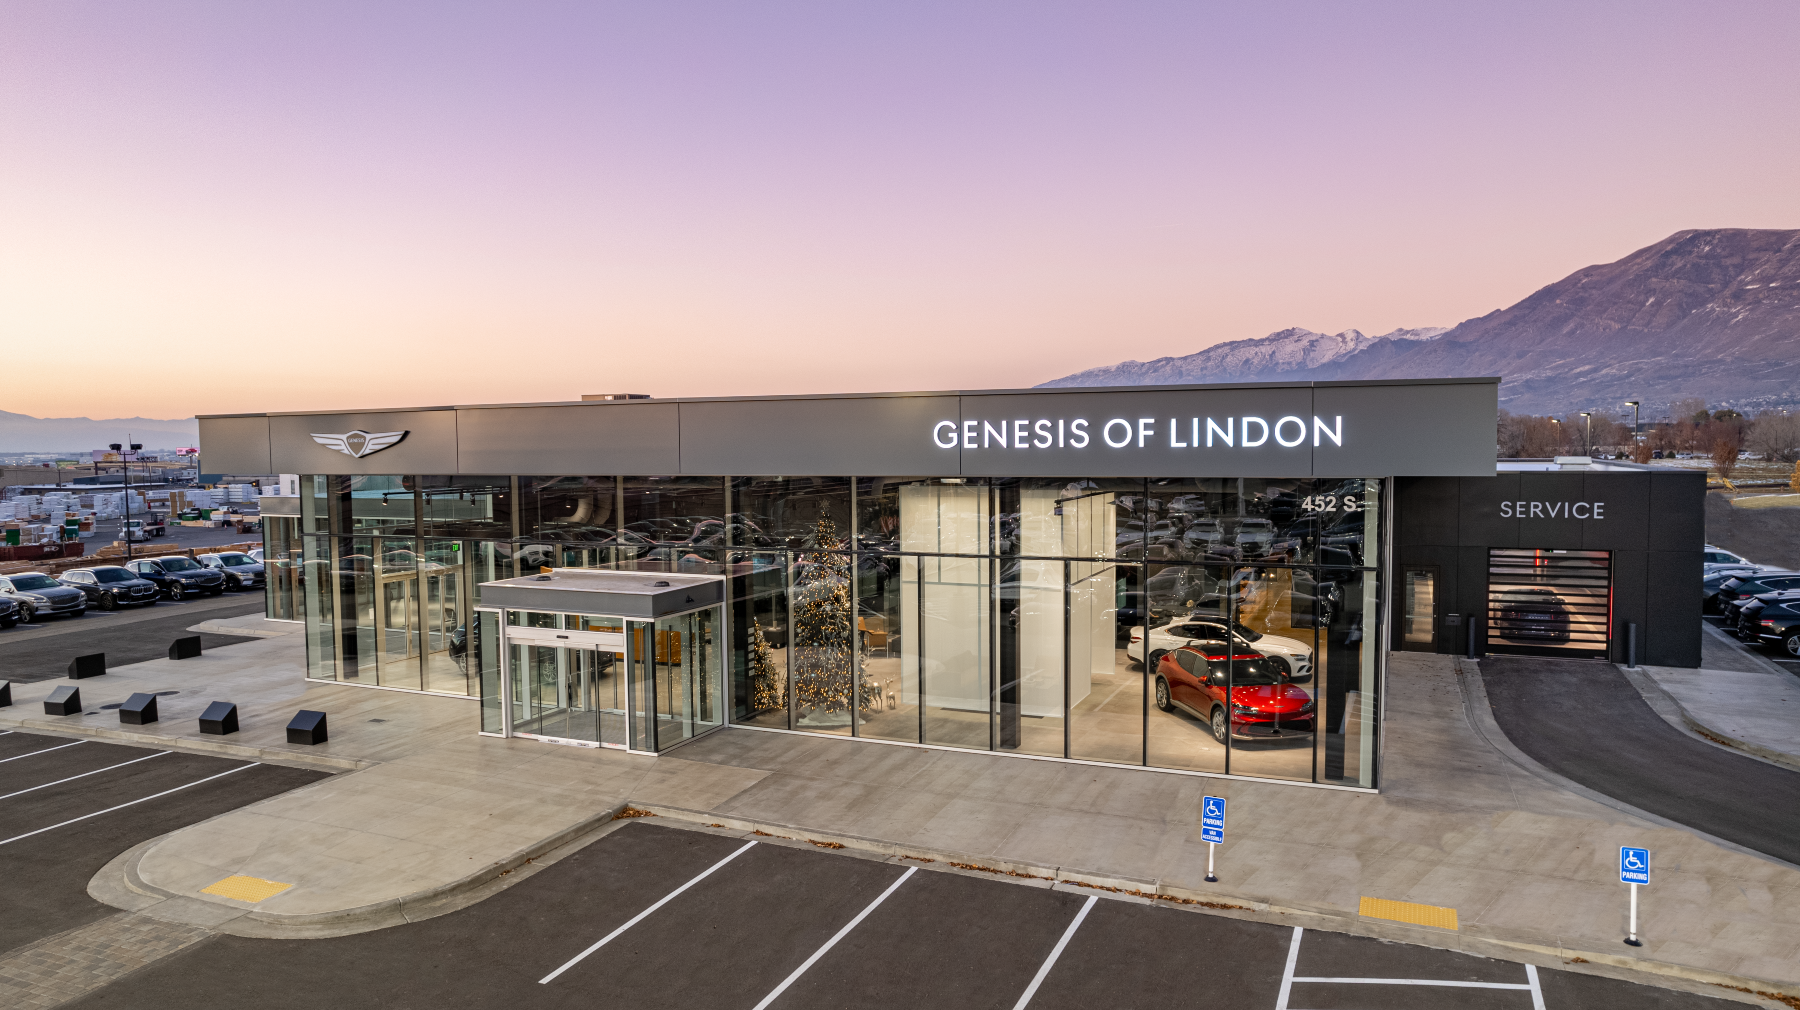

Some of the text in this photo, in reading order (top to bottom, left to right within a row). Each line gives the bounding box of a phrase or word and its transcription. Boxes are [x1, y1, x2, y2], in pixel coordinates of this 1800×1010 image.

[933, 415, 1342, 448] GENESIS OF LINDON
[1301, 495, 1362, 512] 452 S.
[1499, 500, 1605, 519] SERVICE
[1203, 818, 1223, 826] PARKING
[1622, 871, 1647, 880] PARKING
